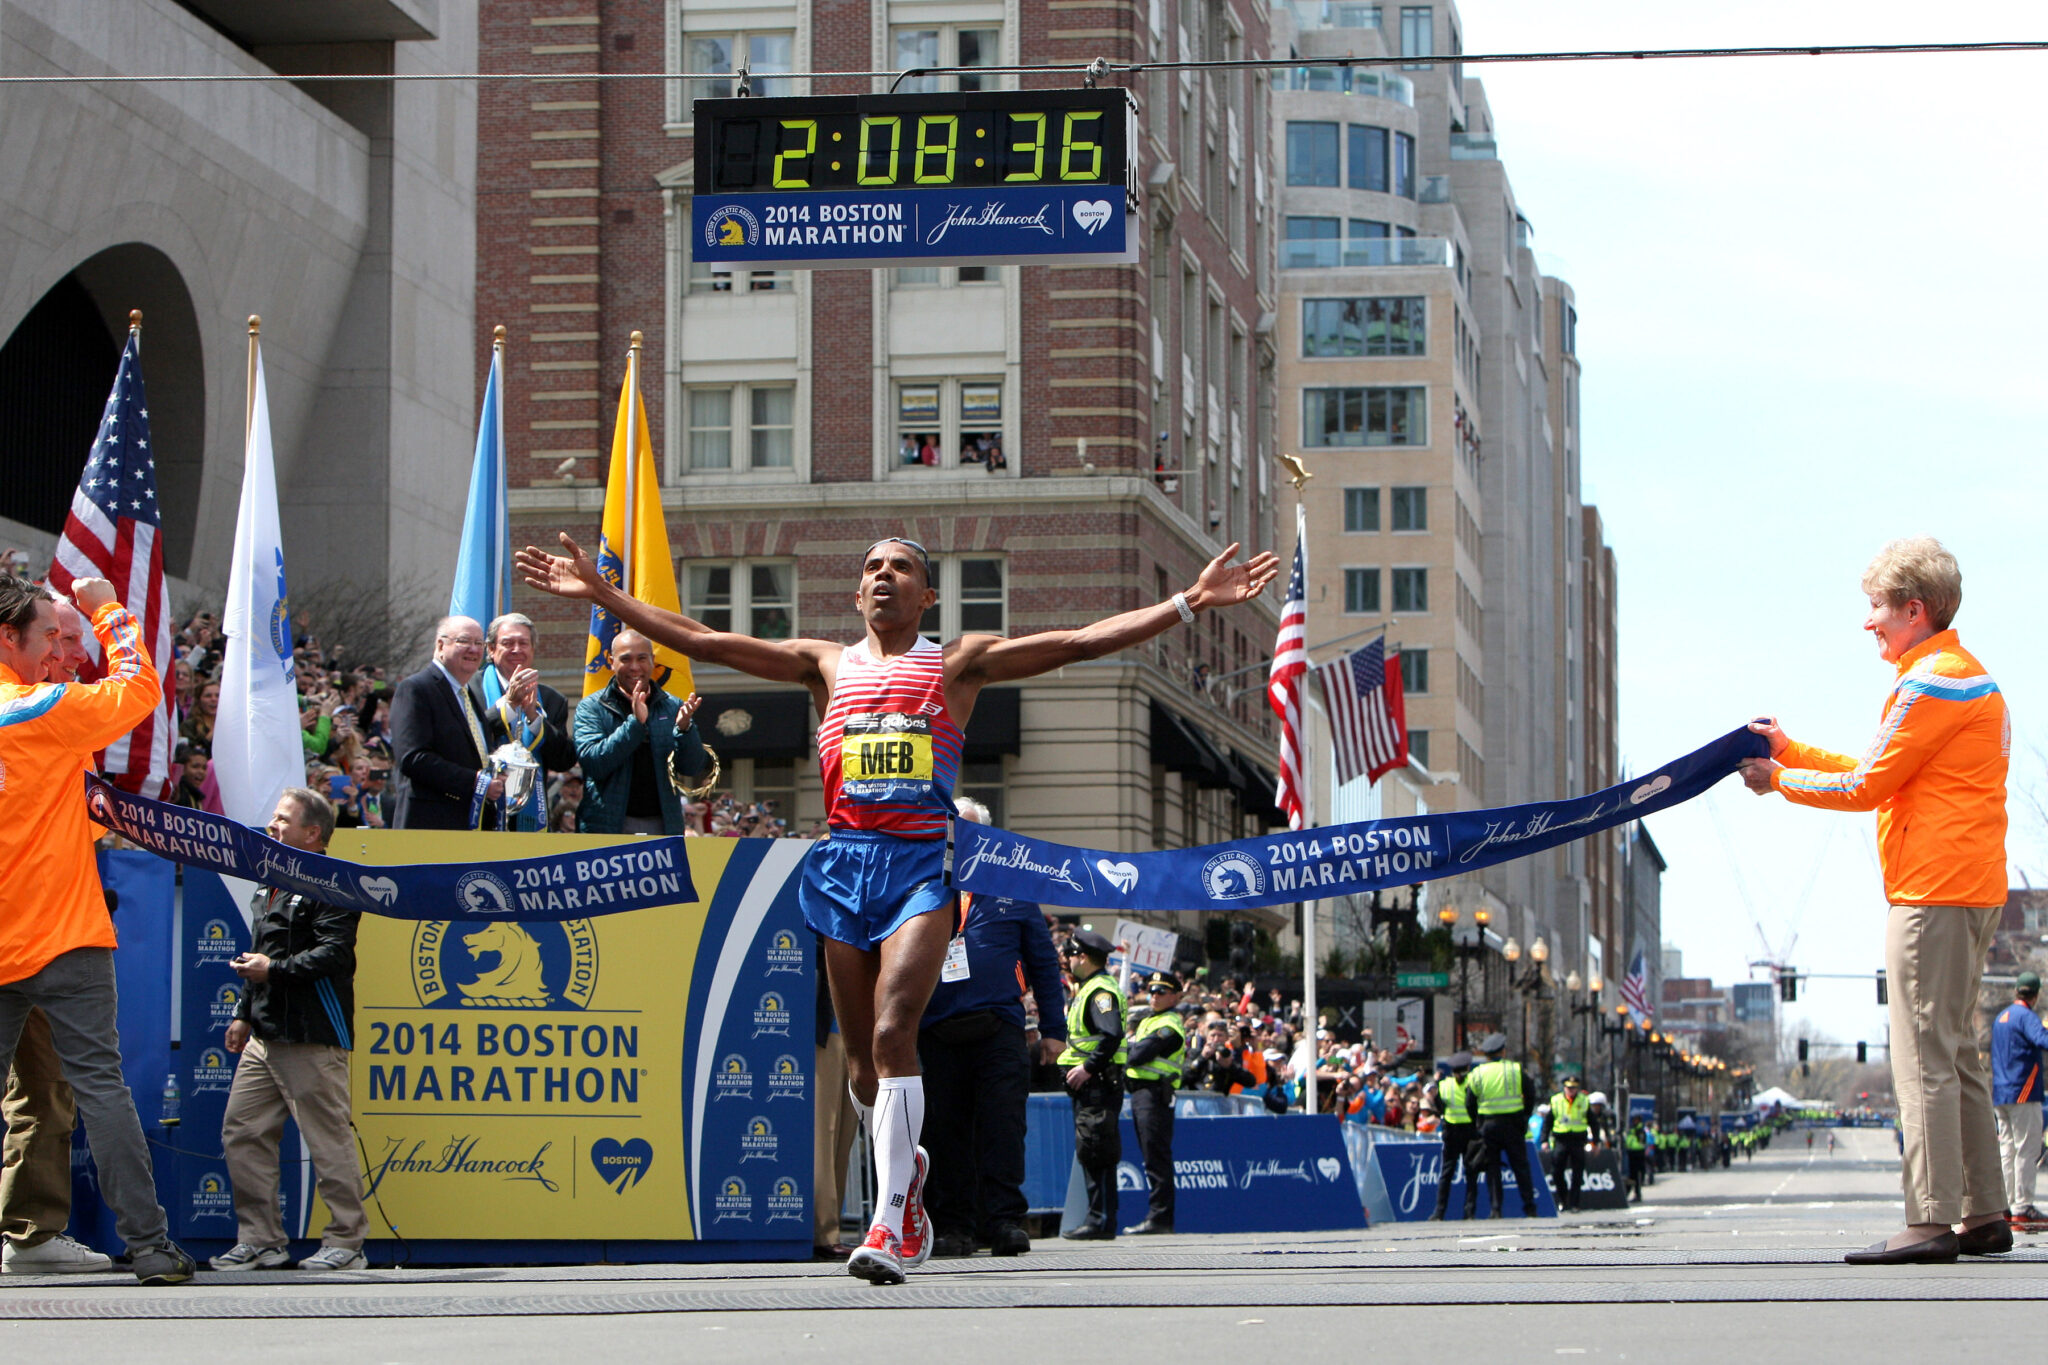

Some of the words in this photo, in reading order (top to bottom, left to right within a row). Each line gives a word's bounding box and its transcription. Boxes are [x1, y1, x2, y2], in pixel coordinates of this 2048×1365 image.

[773, 112, 1103, 188] 2:08:36
[765, 206, 810, 223] 2014
[820, 204, 901, 222] BOSTON
[765, 224, 903, 246] MARATHON
[860, 741, 914, 775] MEB
[118, 800, 156, 827] 2014
[163, 812, 233, 845] BOSTON
[1459, 821, 1521, 864] John
[124, 822, 238, 868] MARATHON
[958, 834, 1008, 883] John
[1007, 842, 1084, 893] Hancock
[1267, 840, 1323, 865] 2014
[1331, 825, 1431, 857] BOSTON
[256, 843, 286, 879] John
[284, 855, 356, 900] Hancock
[513, 864, 566, 889] 2014
[575, 848, 674, 882] BOSTON
[1272, 850, 1433, 893] MARATHON
[518, 873, 681, 912] MARATHON
[418, 920, 444, 996] BOSTON
[566, 919, 593, 997] CIATION
[369, 1021, 462, 1056] 2014
[477, 1022, 639, 1058] BOSTON
[369, 1064, 639, 1103] MARATHON
[431, 1133, 560, 1193] Hancock
[602, 1156, 642, 1165] BOSTON
[1174, 1160, 1224, 1173] BOSTON
